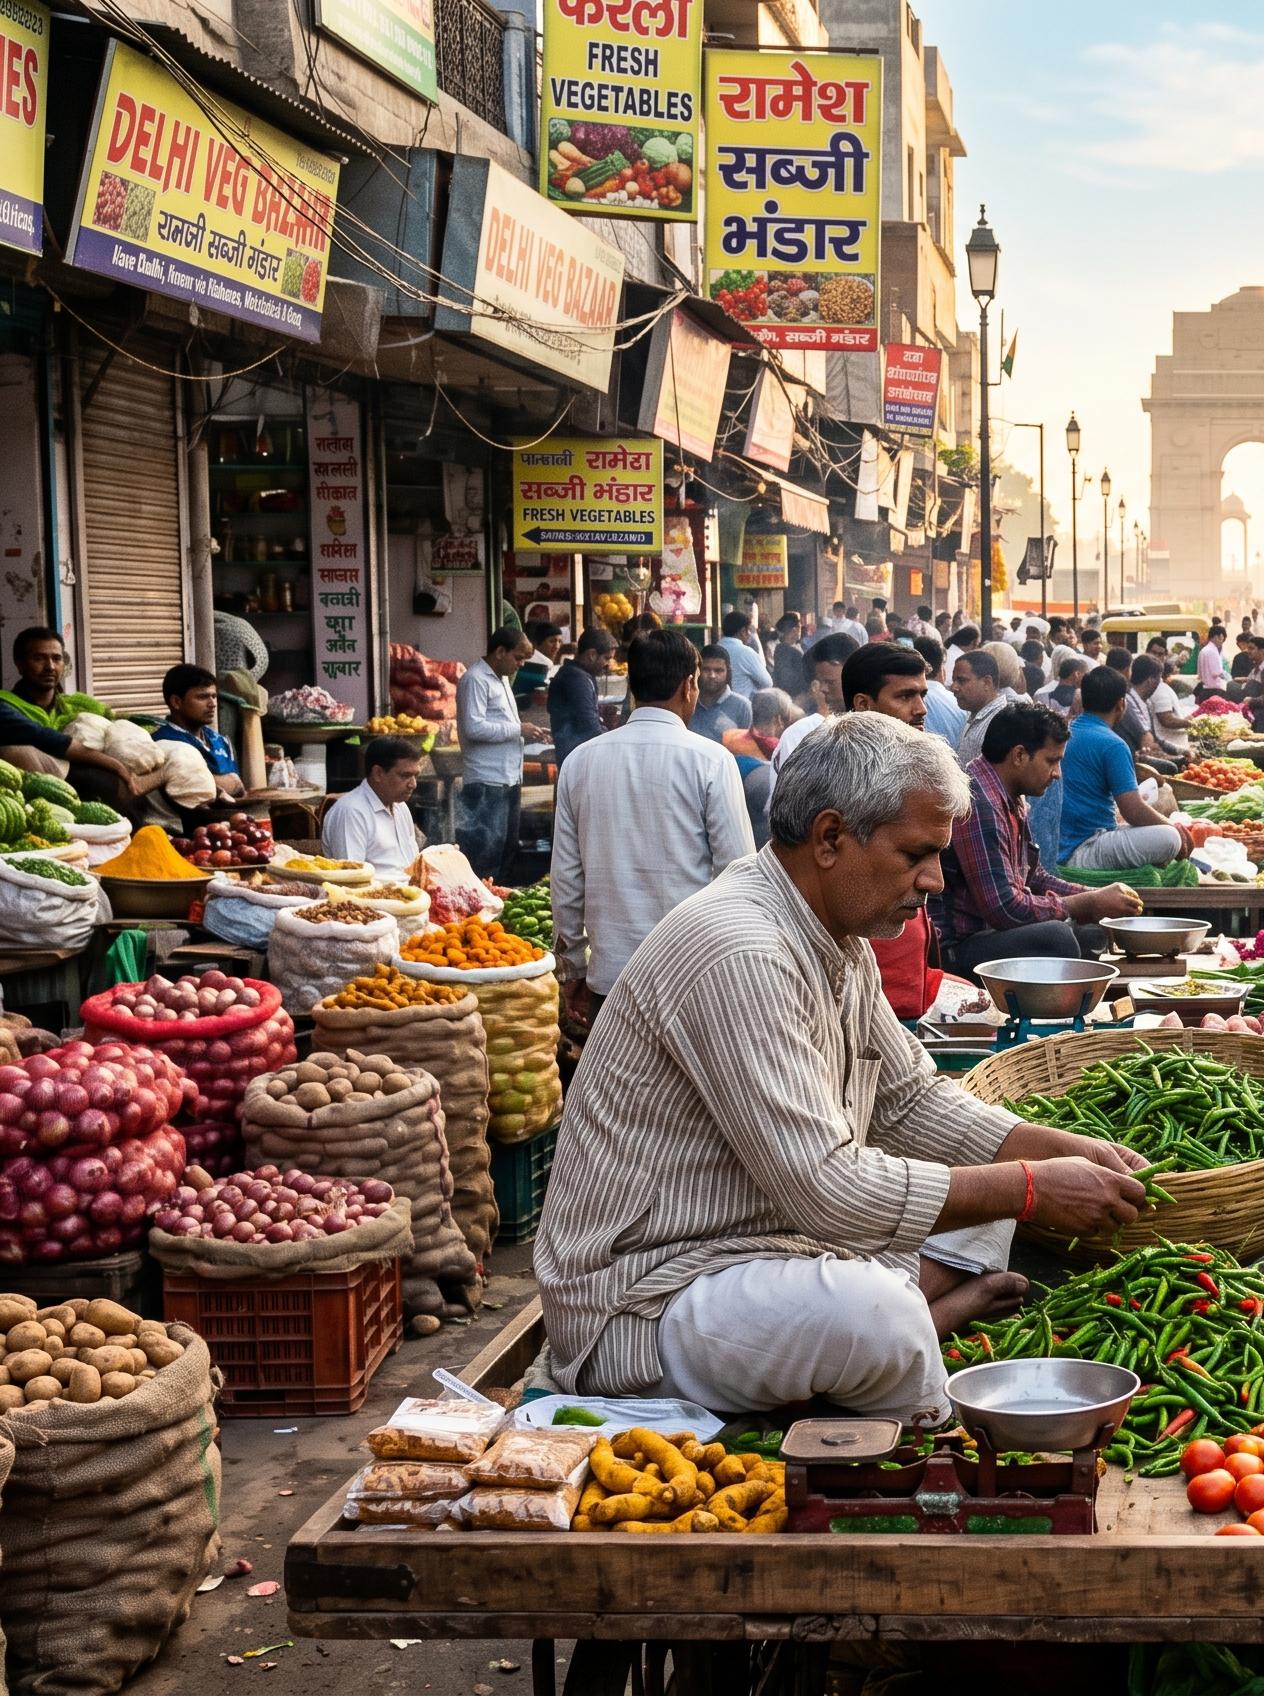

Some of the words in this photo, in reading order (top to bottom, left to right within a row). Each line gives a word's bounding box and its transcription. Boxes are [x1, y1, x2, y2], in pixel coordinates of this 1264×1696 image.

[588, 41, 659, 78] FRESH
[551, 78, 693, 122] VEGETABLES
[718, 60, 870, 124] रामेश
[107, 92, 200, 193] DELHI
[203, 137, 252, 217] VEG
[718, 131, 870, 193] सब्जी
[722, 200, 868, 263] भंडार
[484, 206, 535, 292] DELHI
[535, 236, 565, 309] VEG
[563, 255, 617, 328] BAZAAR
[520, 474, 586, 501] सब्जी
[523, 508, 565, 522] FRESH
[570, 509, 655, 523] VEGETABLES
